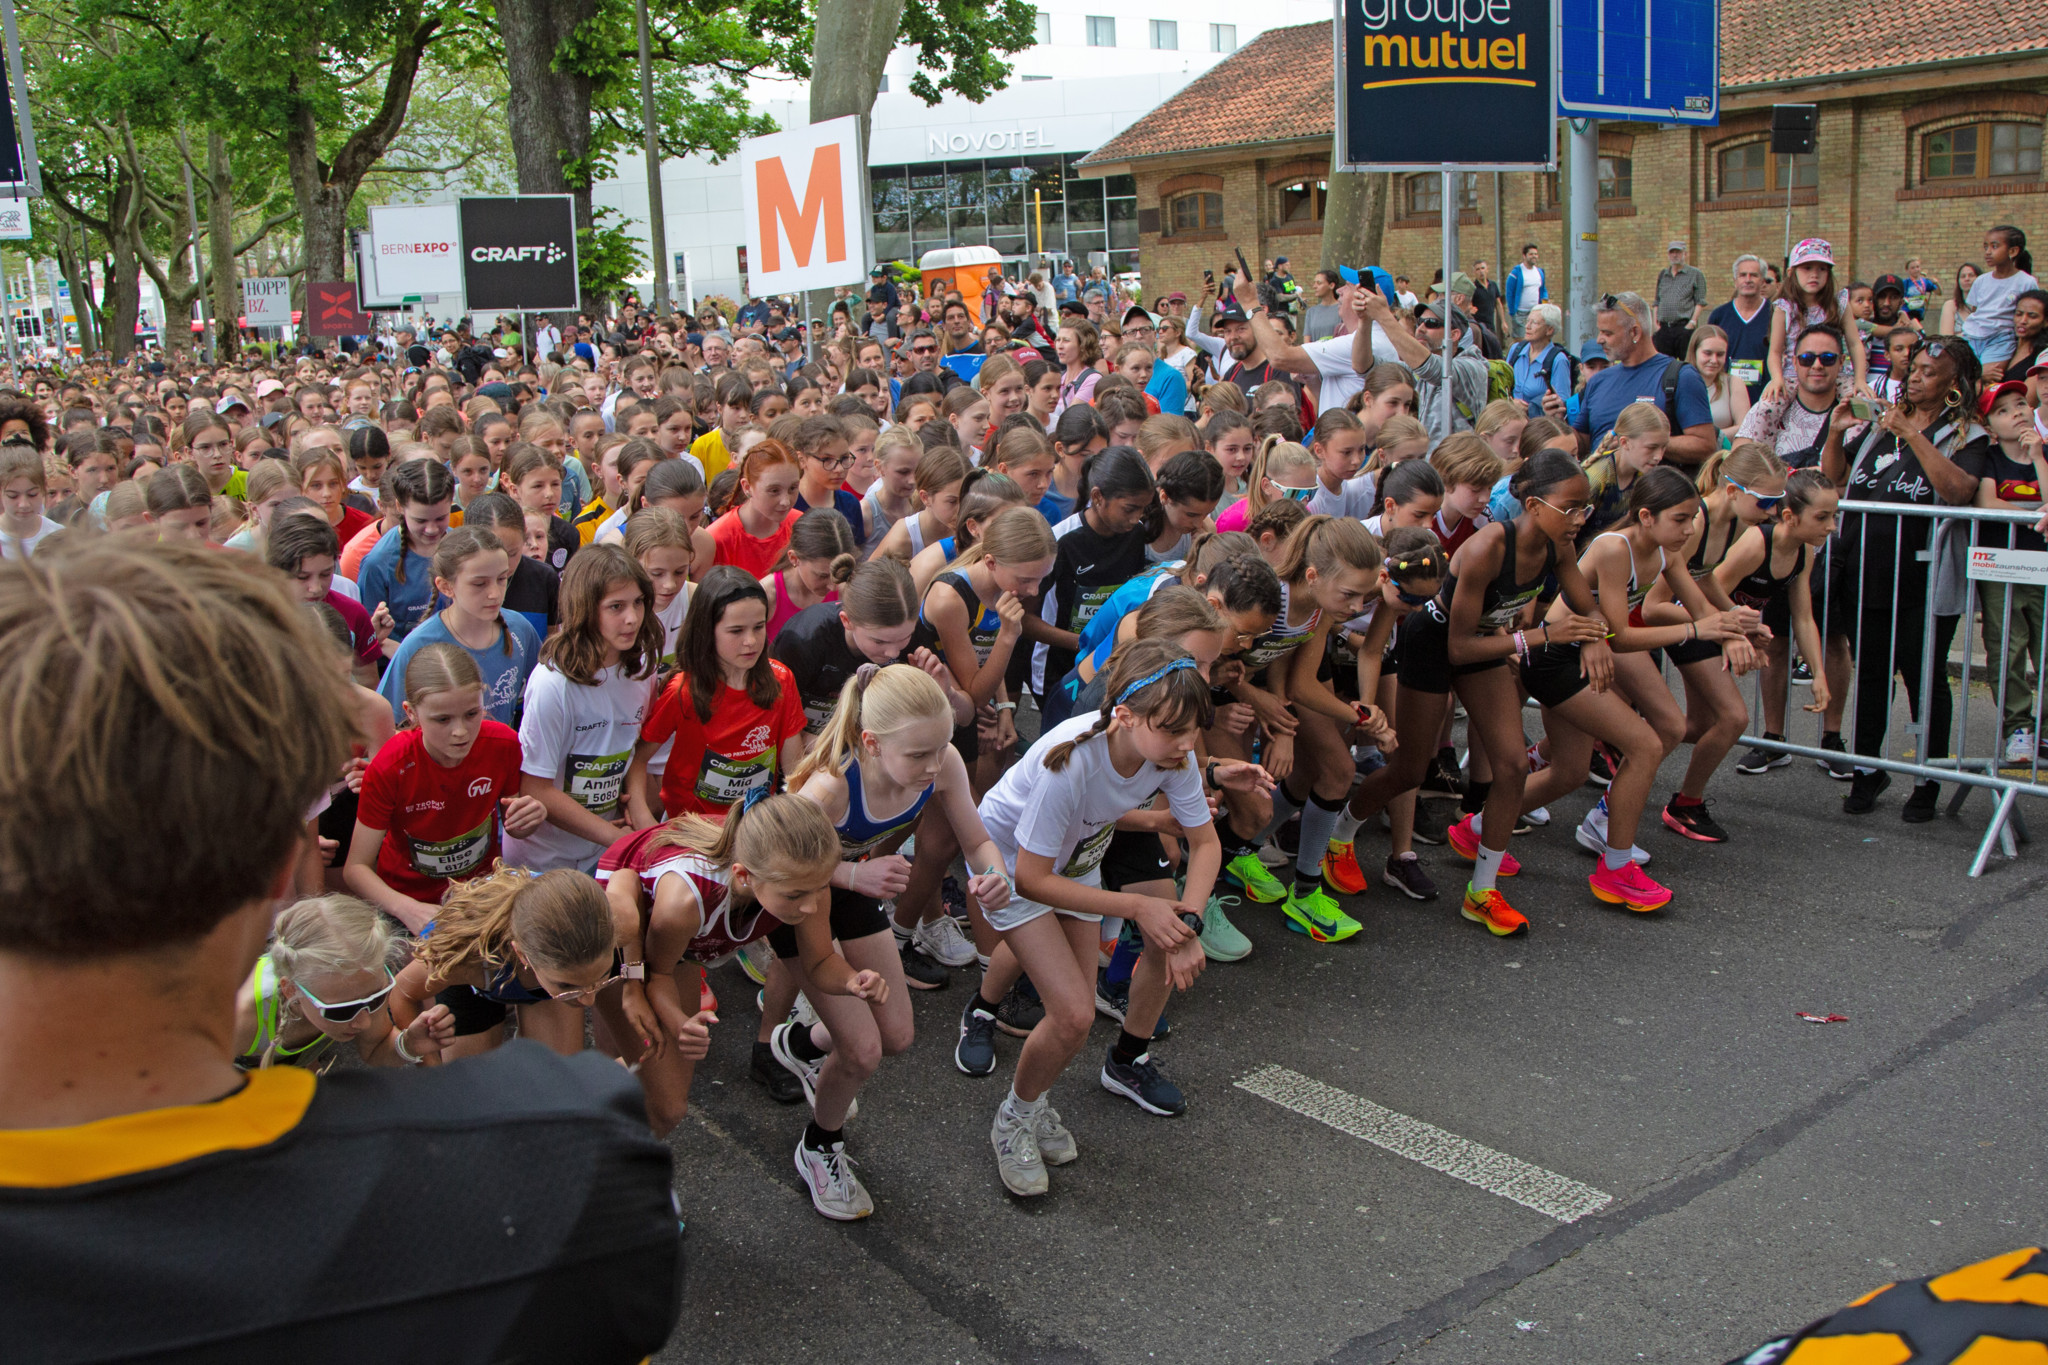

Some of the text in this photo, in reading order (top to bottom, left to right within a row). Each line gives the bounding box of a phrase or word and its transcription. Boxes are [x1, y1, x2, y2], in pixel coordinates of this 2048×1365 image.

[1361, 0, 1511, 33] groupe
[1364, 30, 1526, 70] mutuel
[928, 126, 1054, 154] NOVOTEL
[755, 142, 847, 274] M
[381, 242, 449, 255] BERNEXPO
[471, 246, 546, 262] CRAFT
[246, 280, 287, 296] HOPP!
[248, 298, 269, 313] BZ.
[1973, 551, 1997, 562] mz
[1081, 592, 1112, 600] CRAFT
[575, 721, 602, 732] CRAFT
[574, 761, 615, 772] CRAFT
[710, 758, 750, 774] CRAFT
[728, 778, 753, 788] Mia
[723, 788, 747, 797] 624
[413, 843, 457, 852] CRAFT
[438, 849, 473, 864] Elise
[444, 860, 470, 872] 6172
